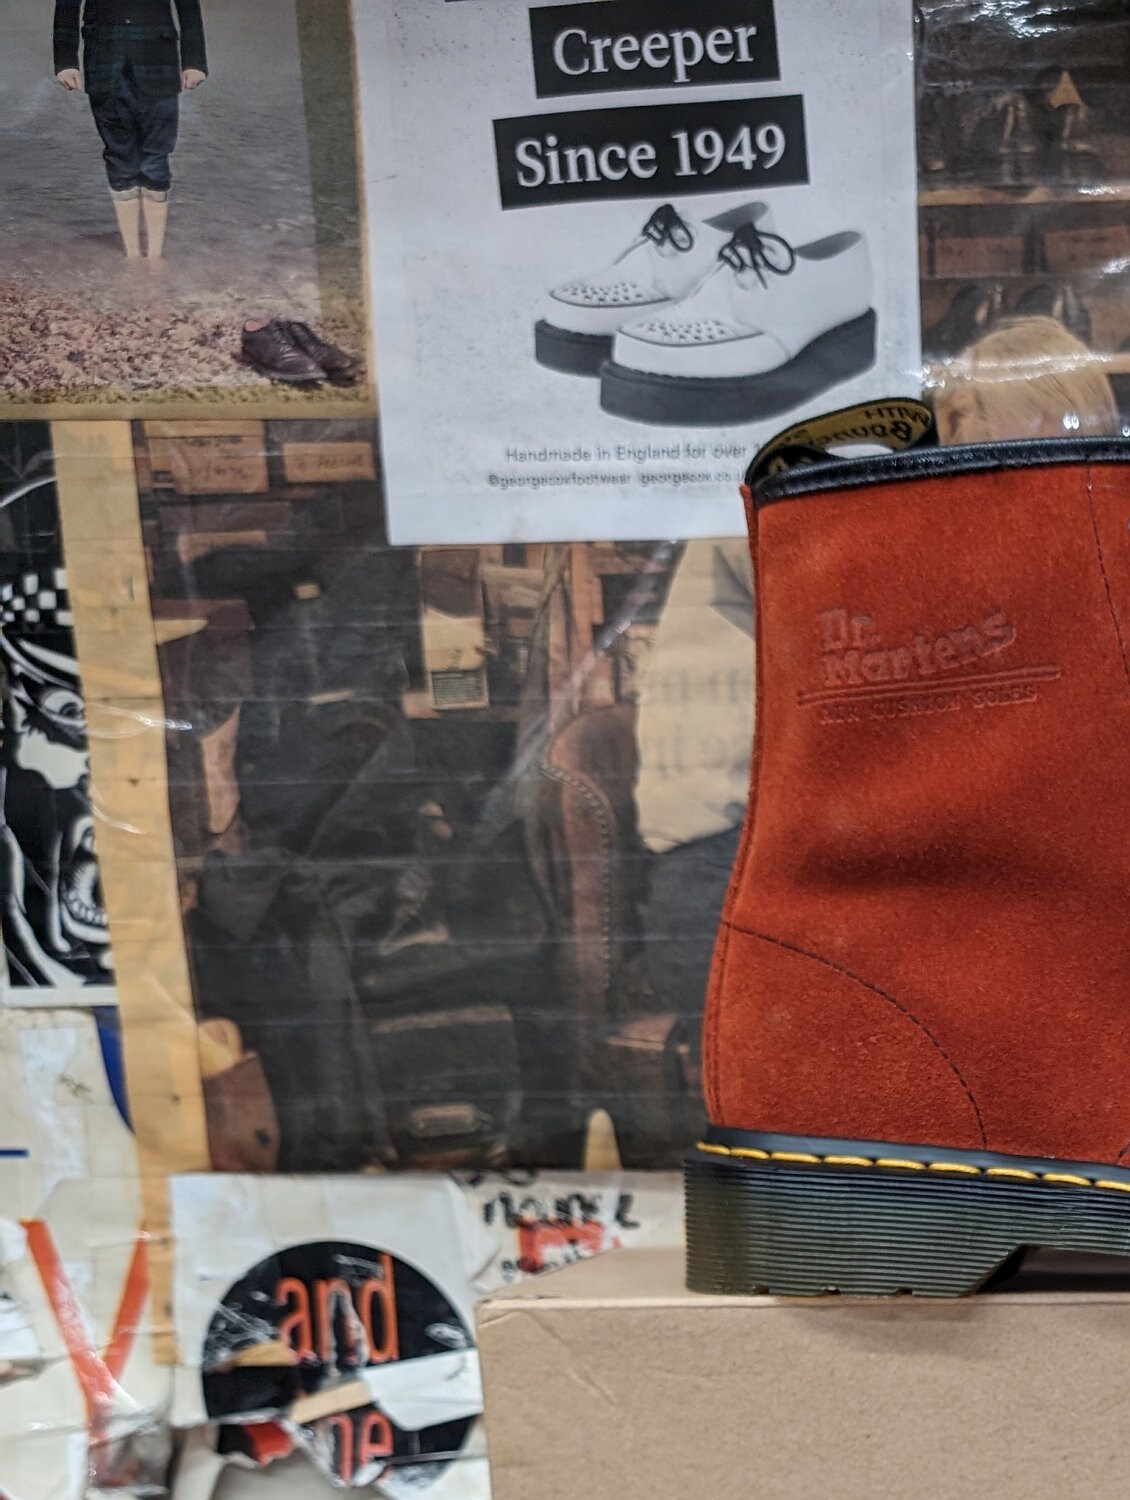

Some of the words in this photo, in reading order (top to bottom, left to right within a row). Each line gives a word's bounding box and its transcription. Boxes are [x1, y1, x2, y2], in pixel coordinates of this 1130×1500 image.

[553, 24, 757, 84] Creeper
[515, 135, 659, 187] Since
[671, 123, 786, 177] 1949
[506, 447, 591, 462] Handmade
[597, 447, 611, 460] in
[617, 444, 680, 464] England
[684, 444, 706, 458] for
[712, 446, 746, 459] over
[818, 608, 880, 650] Dr.
[820, 608, 1016, 688] Martens
[275, 1252, 398, 1365] and
